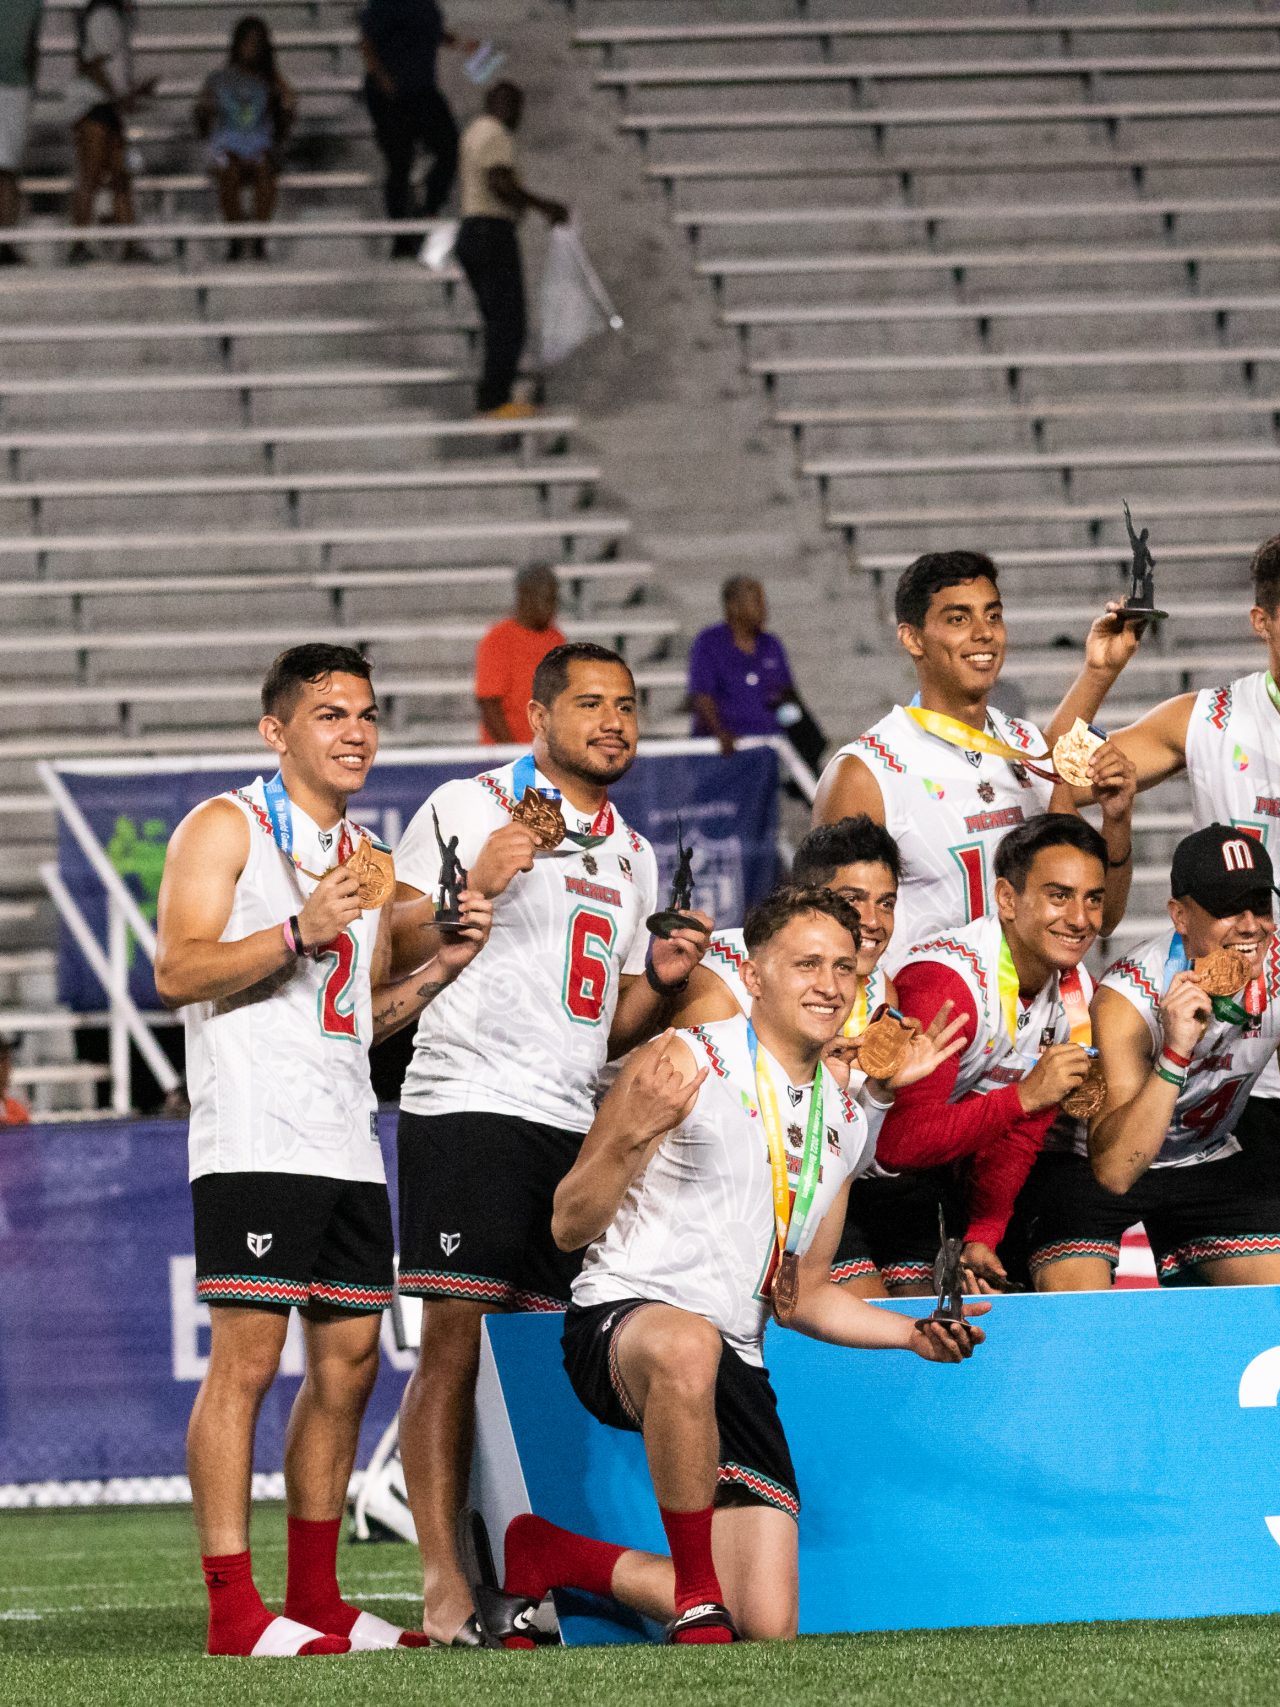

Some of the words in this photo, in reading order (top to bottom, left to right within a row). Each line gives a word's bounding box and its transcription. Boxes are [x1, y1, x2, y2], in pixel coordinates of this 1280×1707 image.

[278, 813, 289, 833] World
[316, 926, 362, 1046] 2
[561, 904, 618, 1028] 6
[802, 1152, 816, 1199] Birmingham
[682, 1604, 716, 1620] NIKE
